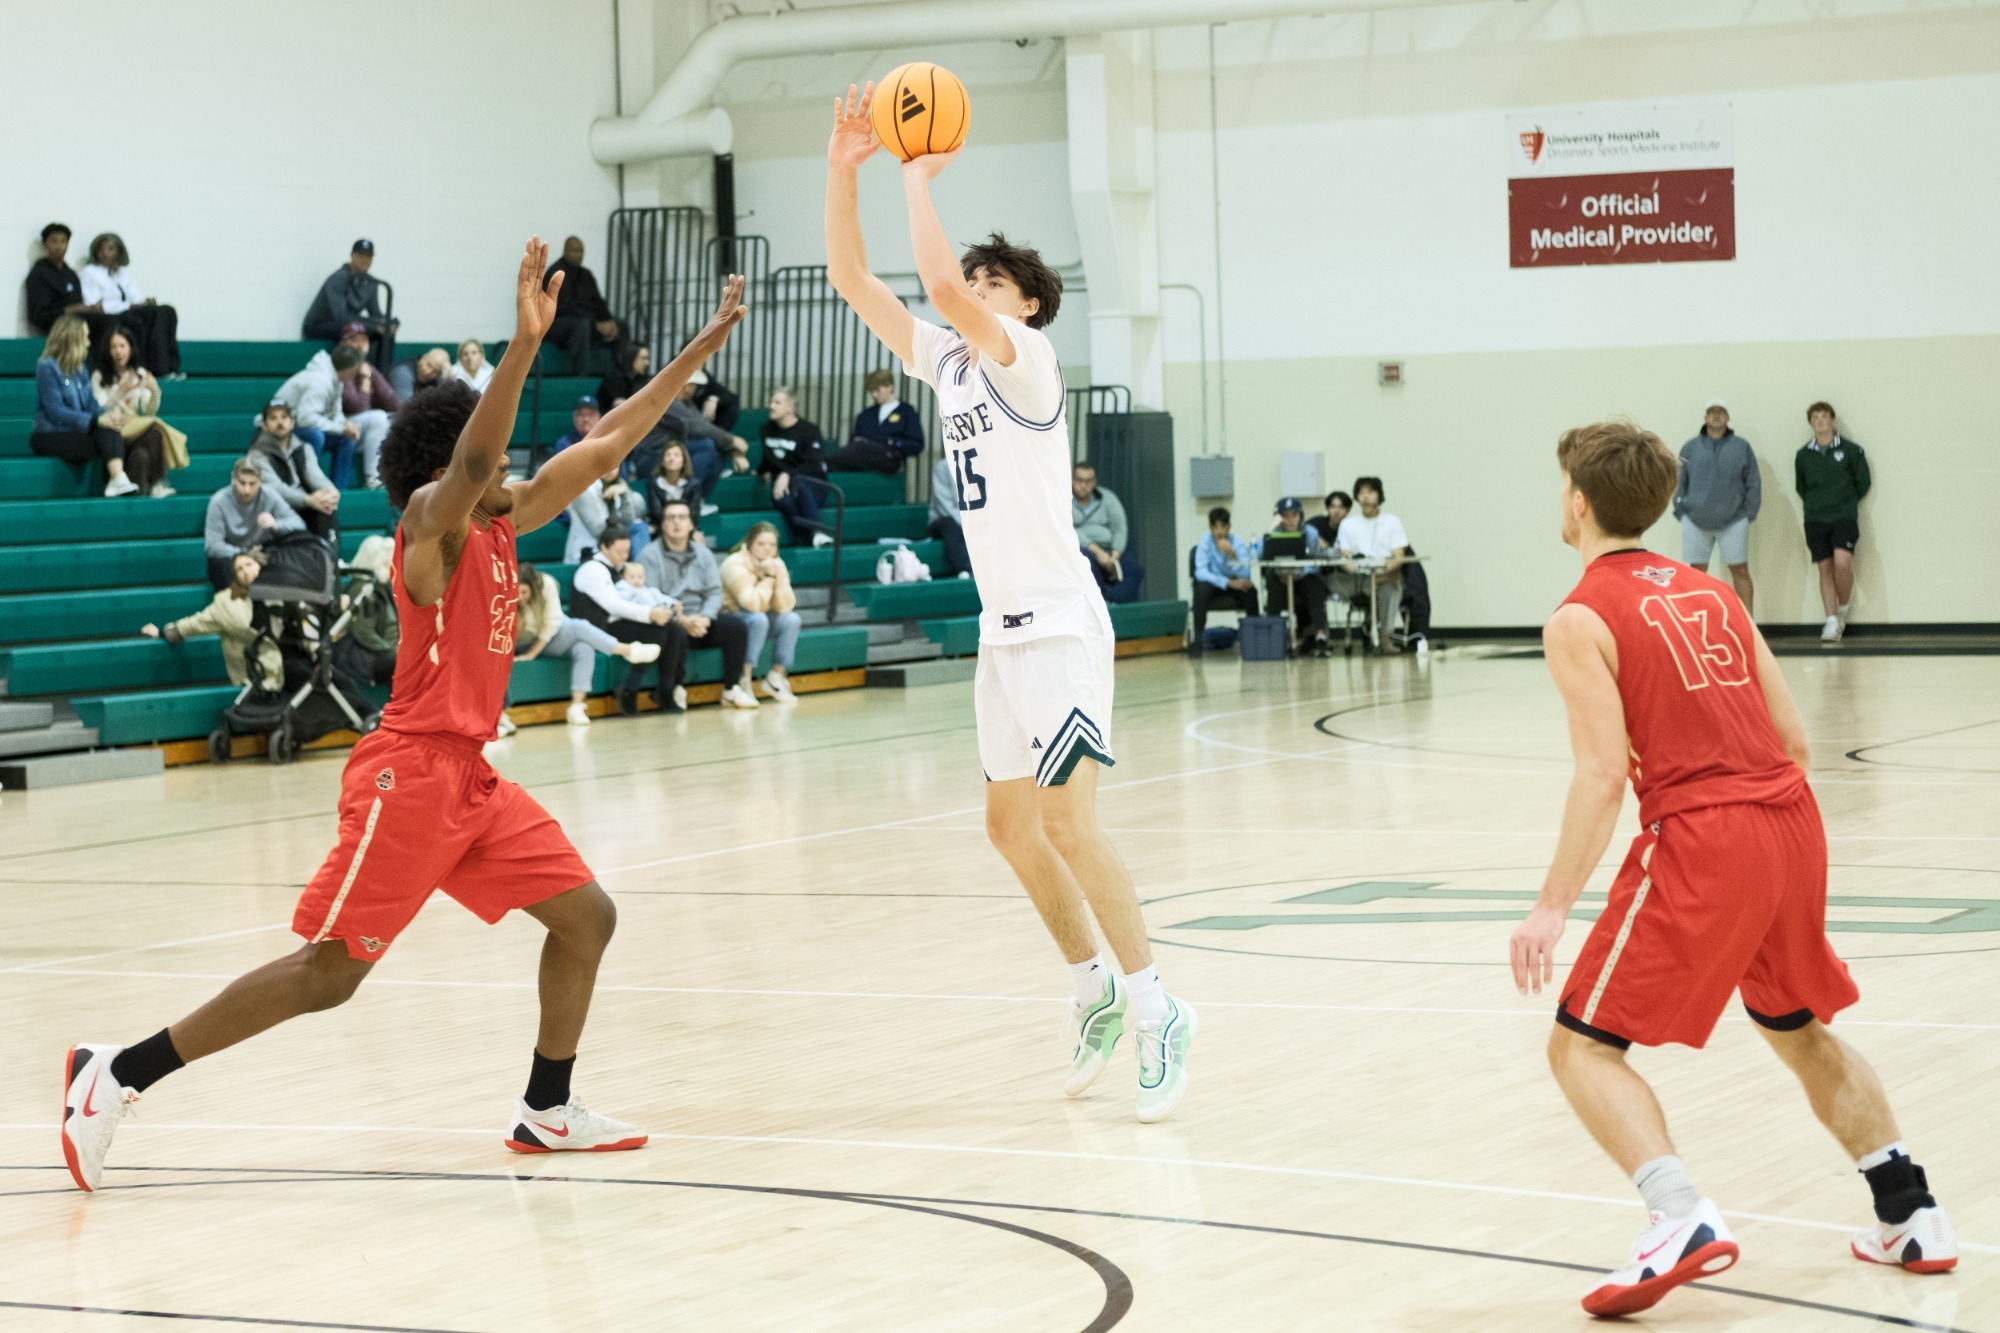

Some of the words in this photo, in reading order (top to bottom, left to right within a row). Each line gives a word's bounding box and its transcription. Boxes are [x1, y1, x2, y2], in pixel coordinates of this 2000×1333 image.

[1547, 132, 1603, 146] University
[1608, 128, 1660, 144] Hospitals
[1632, 142, 1677, 155] Medicine
[1581, 191, 1659, 217] Official
[1530, 224, 1615, 250] Medical
[1621, 220, 1714, 245] Provider
[953, 447, 987, 511] 15
[1640, 590, 1750, 691] 13
